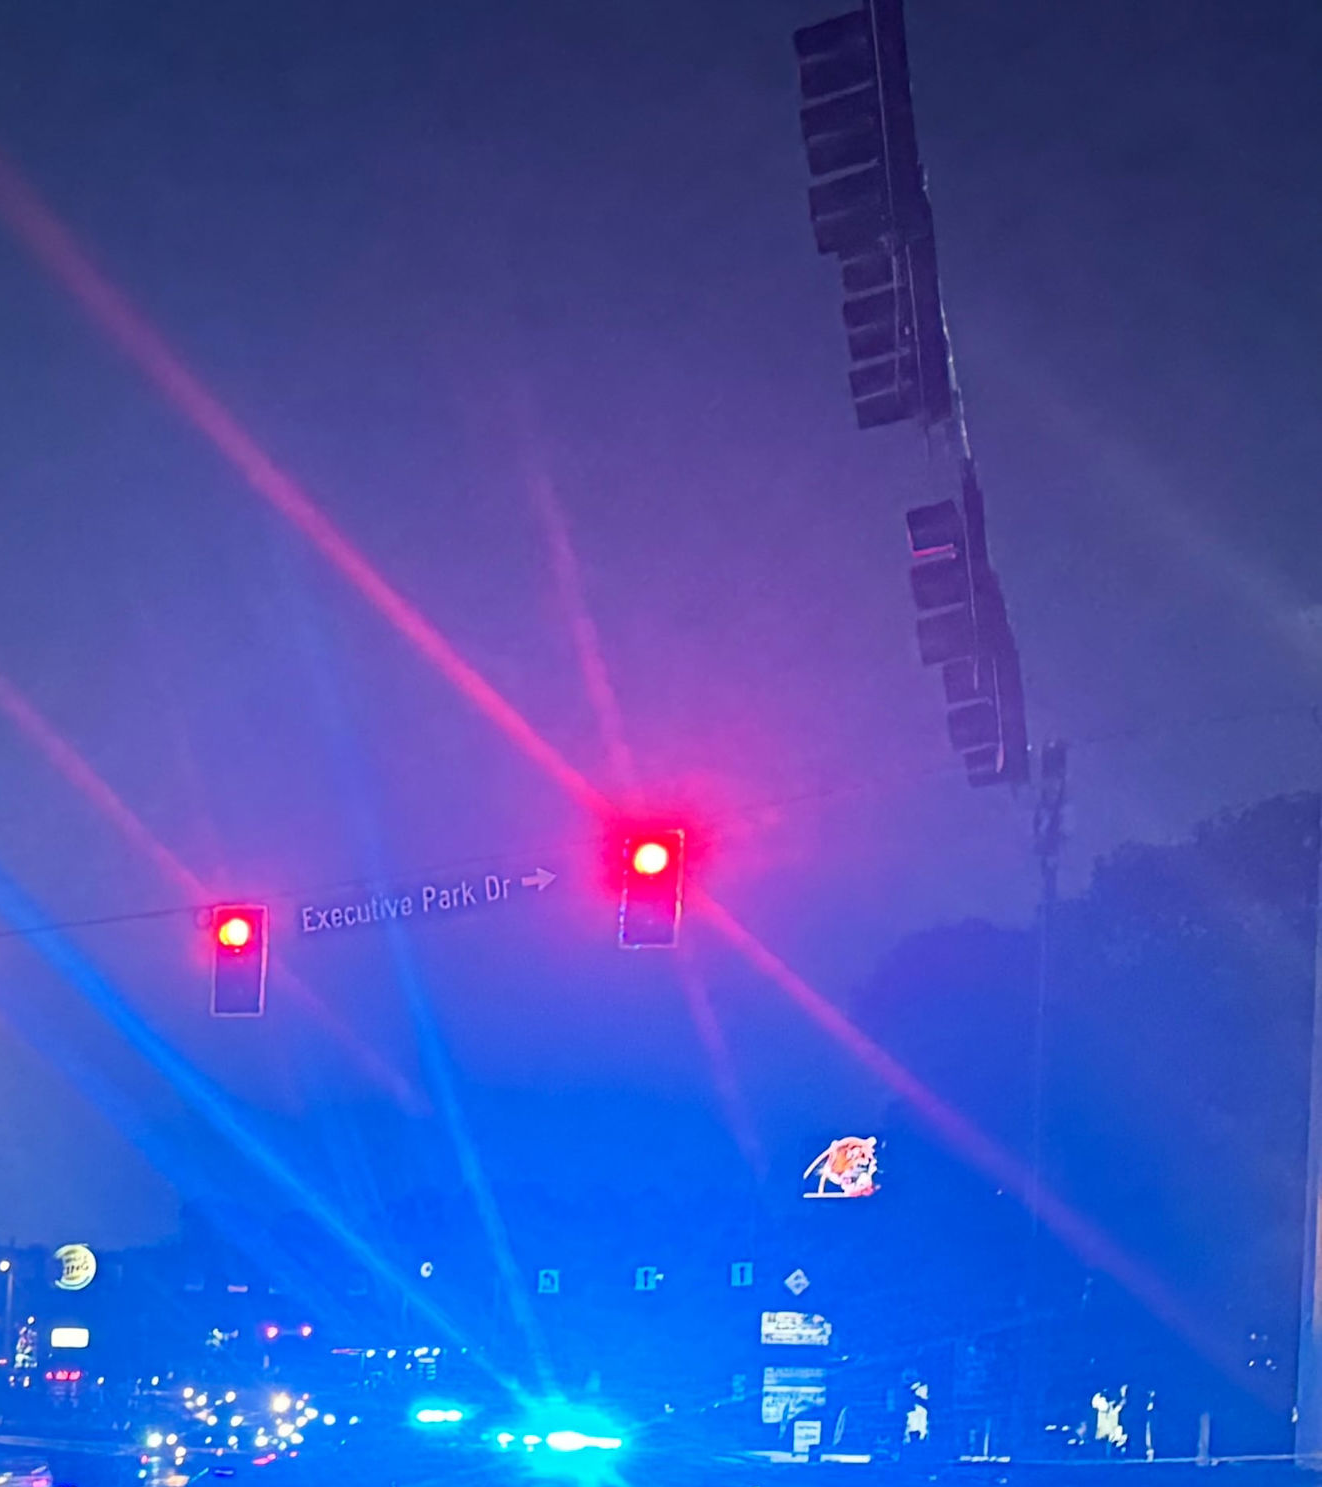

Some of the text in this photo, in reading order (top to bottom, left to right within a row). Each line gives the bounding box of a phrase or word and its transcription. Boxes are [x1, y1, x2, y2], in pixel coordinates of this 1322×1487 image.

[302, 875, 511, 932] Executive Park Dr
